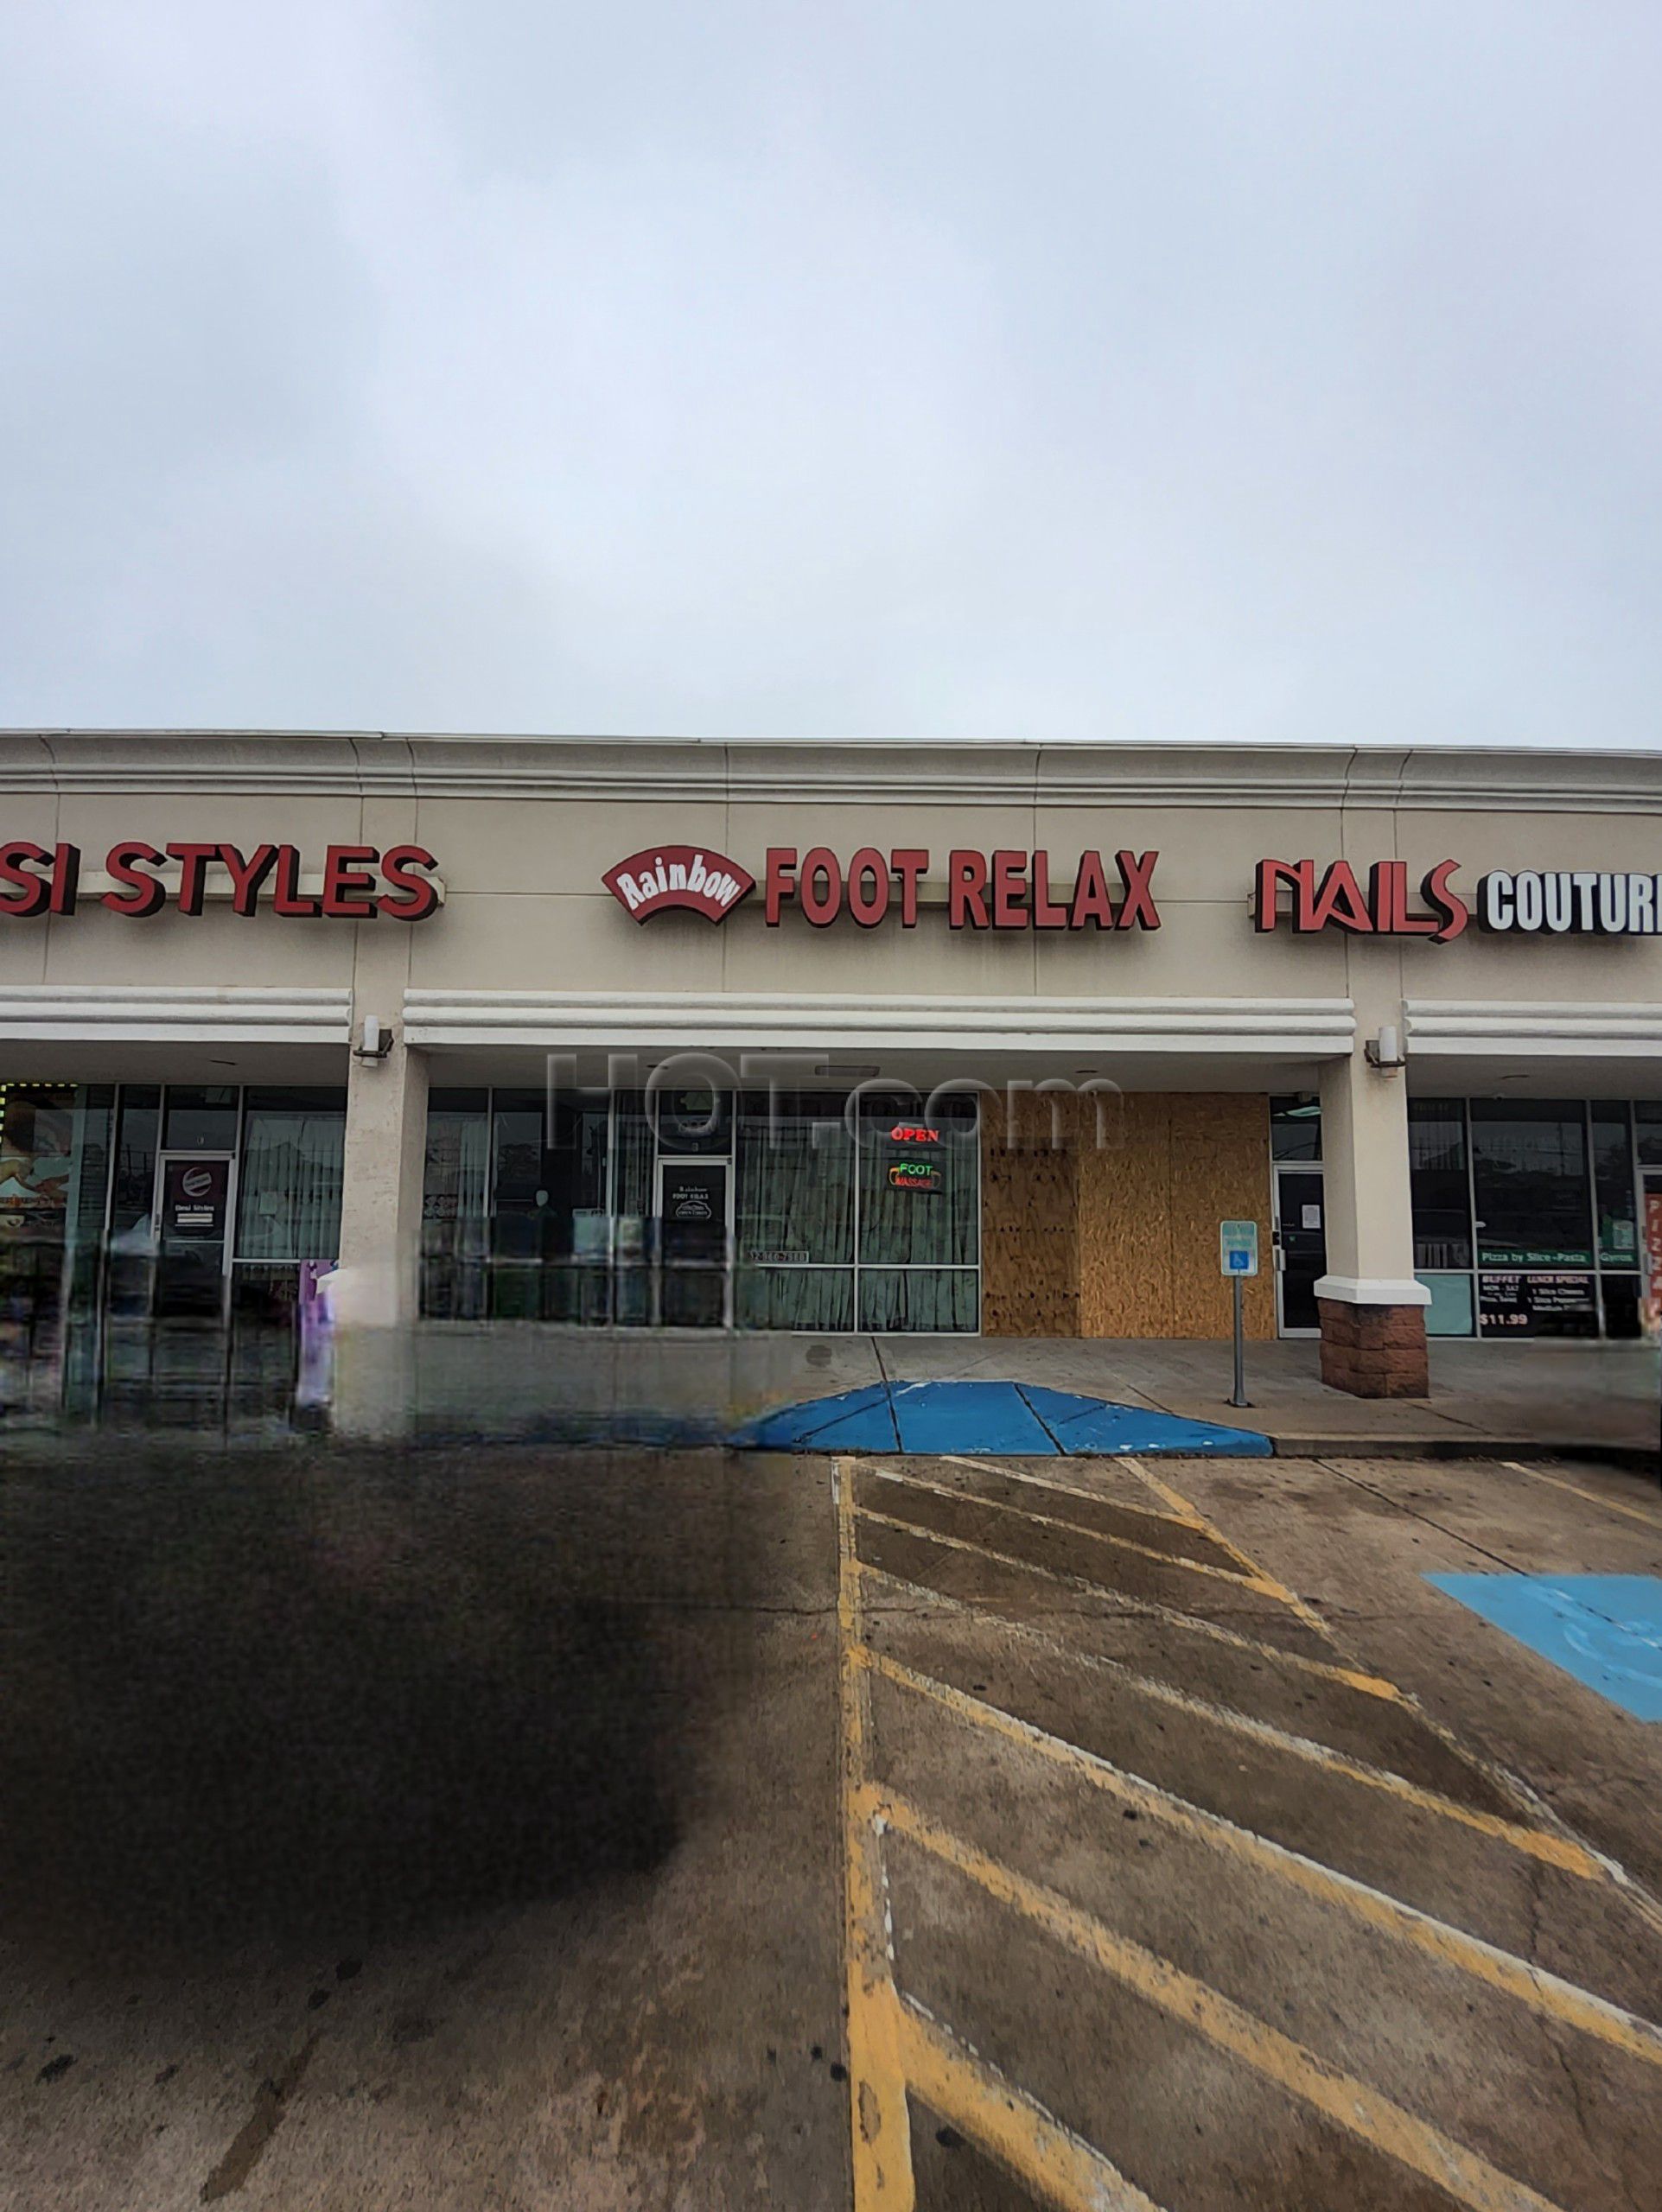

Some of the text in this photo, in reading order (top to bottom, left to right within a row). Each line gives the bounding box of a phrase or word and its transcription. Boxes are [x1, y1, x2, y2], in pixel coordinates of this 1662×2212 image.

[0, 842, 438, 922] SI STYLES
[617, 854, 739, 911] Rainbow
[766, 847, 1162, 931] FOOT RELAX
[1255, 859, 1468, 944] NAILS
[891, 1126, 940, 1142] OPEN
[900, 1163, 933, 1176] FOOT
[1482, 1252, 1508, 1262] Pizza
[1512, 1253, 1523, 1263] by
[1526, 1252, 1551, 1262] Slice
[1482, 1275, 1521, 1284] BUFFET
[1480, 1313, 1528, 1325] $11.99
